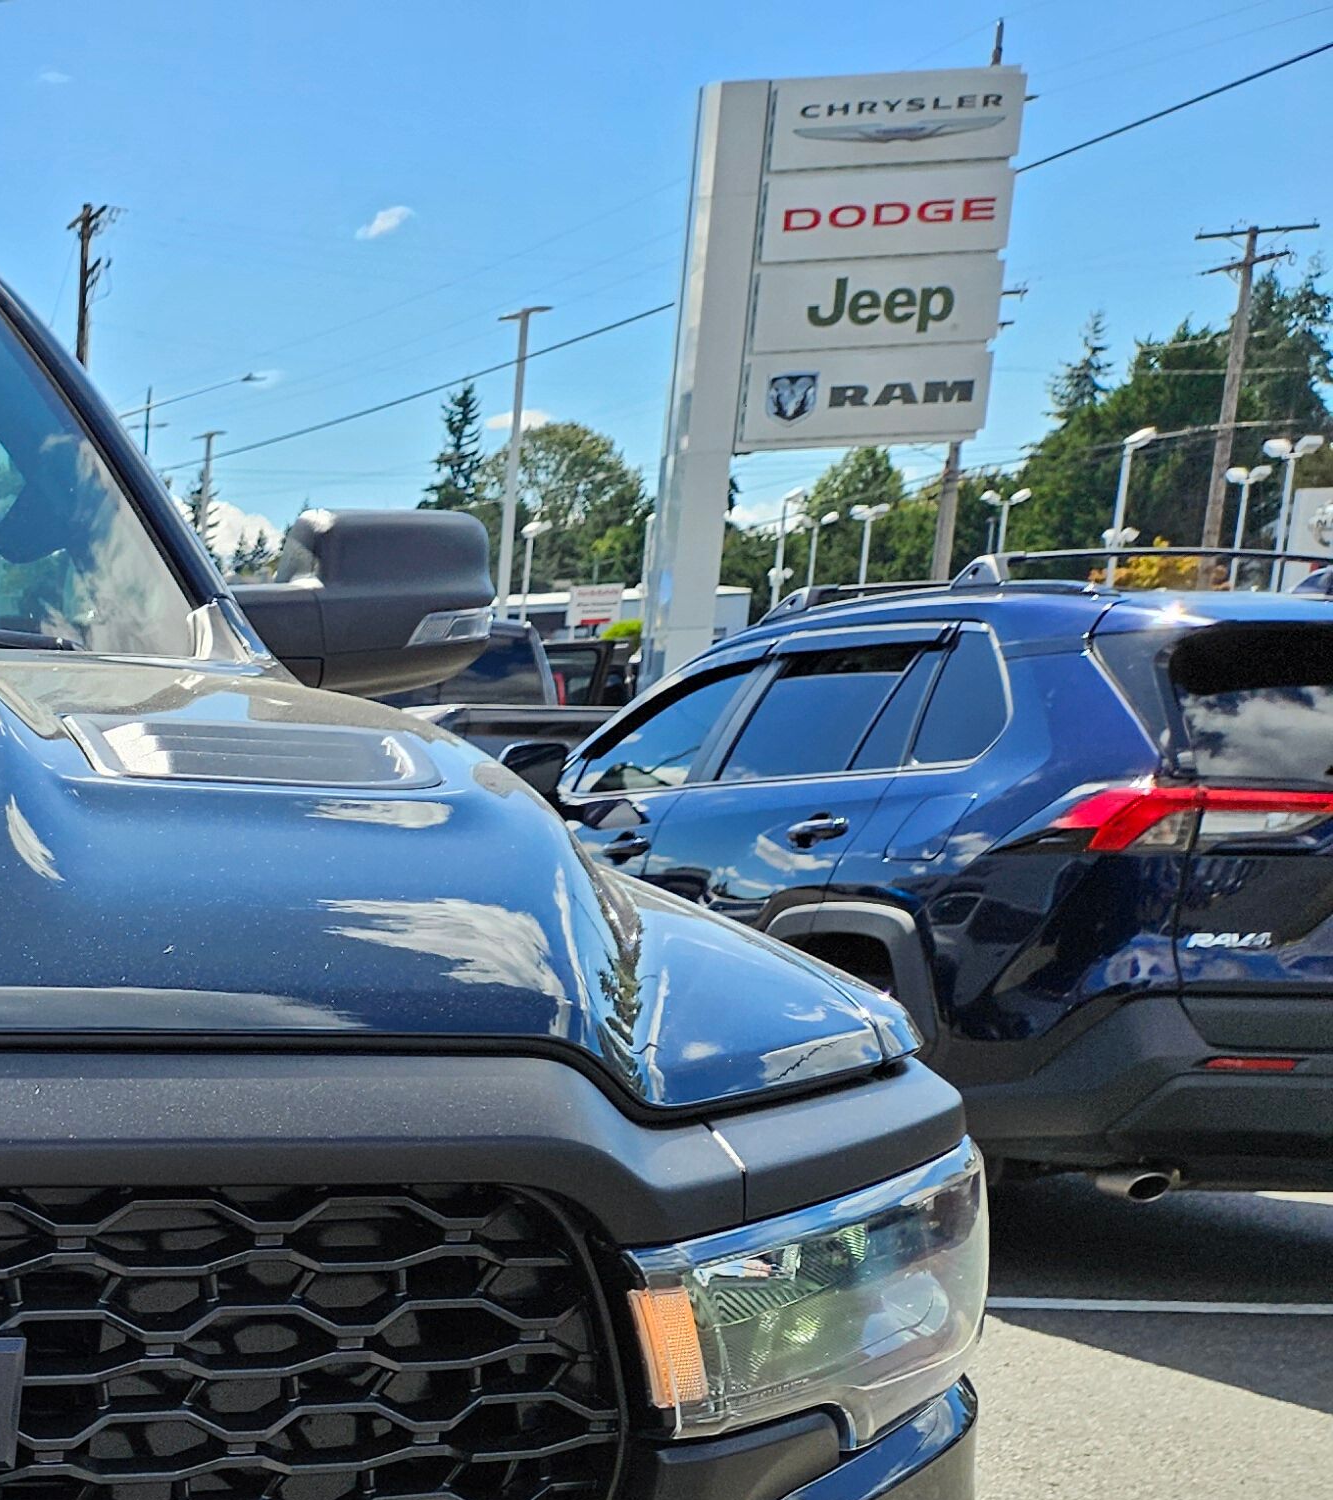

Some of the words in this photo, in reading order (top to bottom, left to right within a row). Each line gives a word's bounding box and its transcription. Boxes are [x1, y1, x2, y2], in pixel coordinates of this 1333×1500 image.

[800, 93, 1004, 119] CHRYSLER
[782, 197, 997, 233] DODGE
[807, 276, 956, 333] Jeep
[827, 379, 976, 410] RAM
